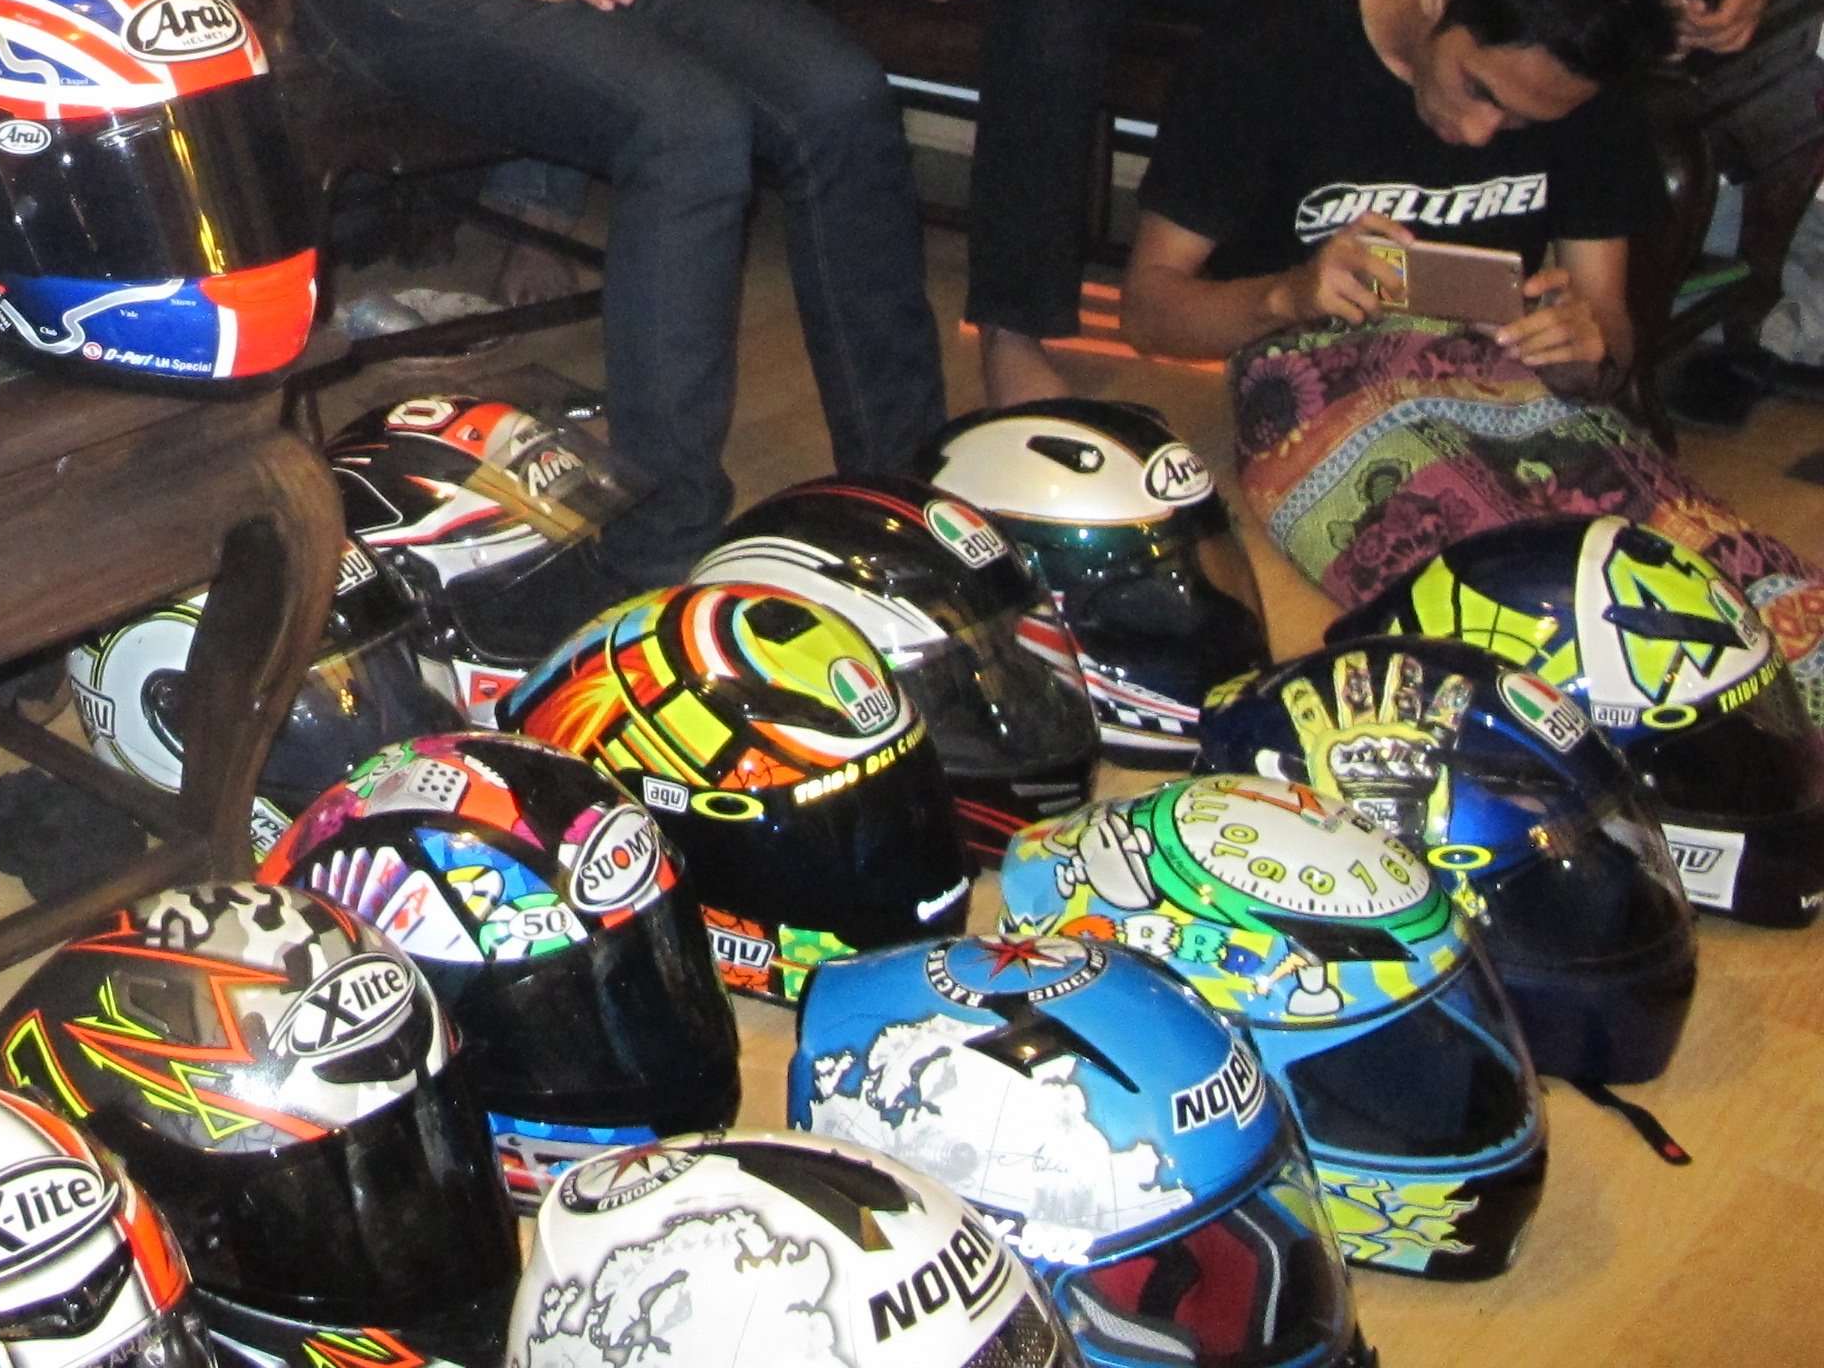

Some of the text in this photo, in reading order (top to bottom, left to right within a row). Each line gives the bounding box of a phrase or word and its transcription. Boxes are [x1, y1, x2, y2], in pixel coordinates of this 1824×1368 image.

[172, 359, 212, 373] Special
[580, 819, 660, 891] SUOMY
[1299, 865, 1336, 895] 8
[1348, 860, 1377, 895] 7
[521, 912, 568, 936] 50
[711, 935, 766, 964] gv
[304, 966, 406, 1052] X-lite
